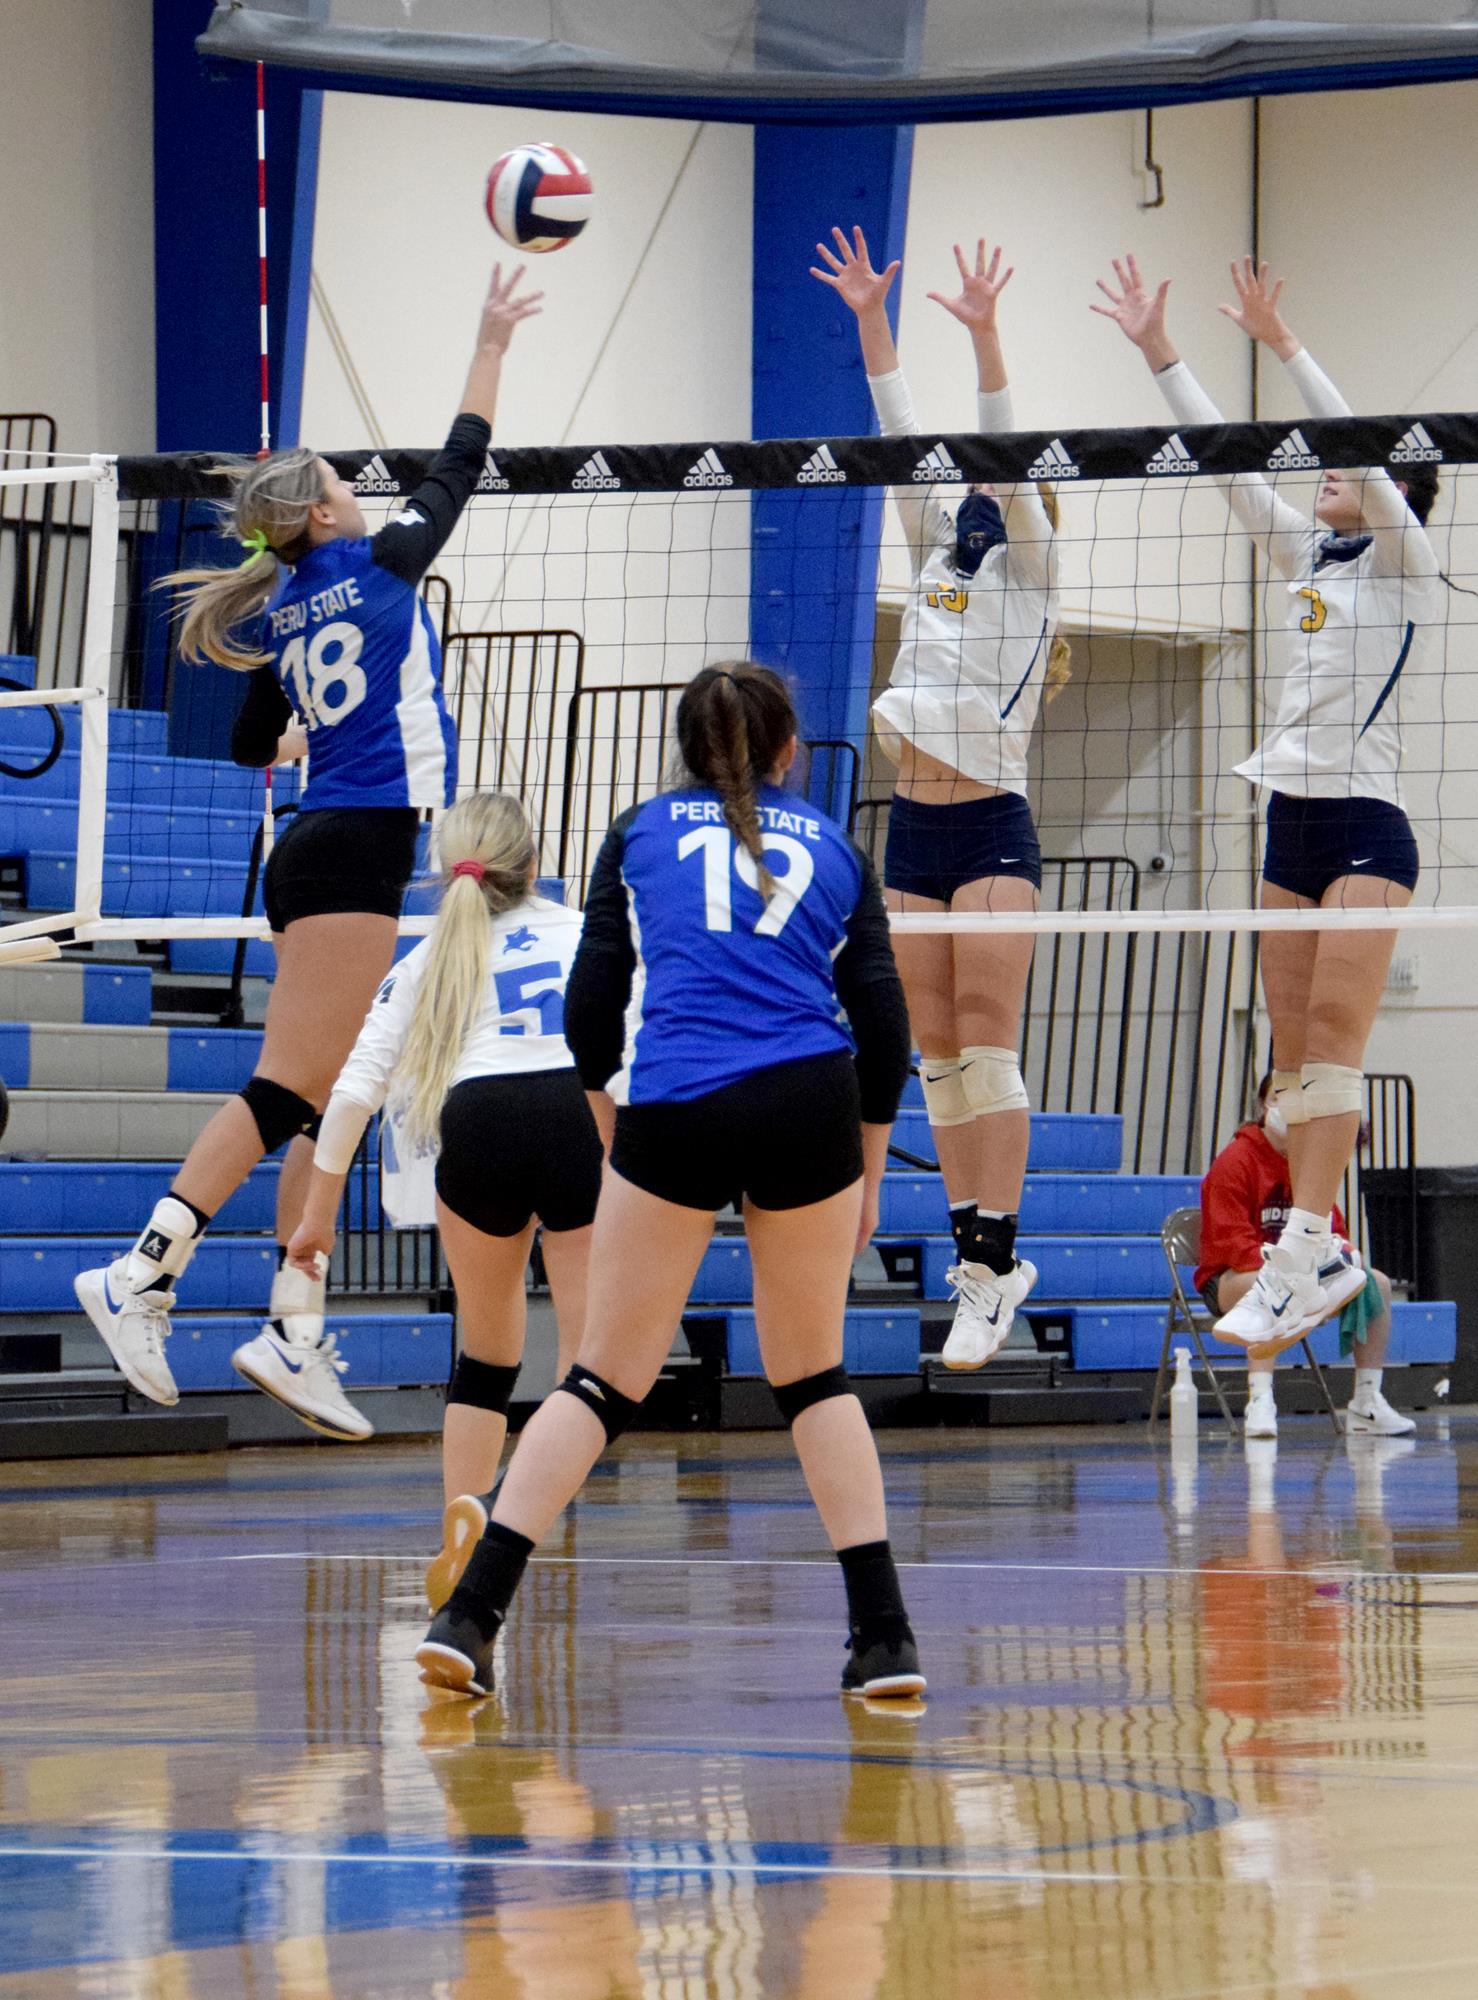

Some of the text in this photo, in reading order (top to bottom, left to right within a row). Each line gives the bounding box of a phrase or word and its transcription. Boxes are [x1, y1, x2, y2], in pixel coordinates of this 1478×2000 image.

[1267, 453, 1320, 469] adidas
[1389, 447, 1443, 463] adidas
[912, 467, 963, 481] adidas
[1027, 463, 1080, 479] adidas
[1146, 458, 1199, 474] adidas
[571, 475, 621, 490] adidas
[683, 472, 733, 487] adidas
[797, 469, 847, 483] adidas
[353, 477, 400, 492] adidas
[269, 577, 364, 638] PERU STATE
[1296, 586, 1327, 633] 3
[280, 621, 367, 731] 18
[670, 801, 727, 822] PER
[678, 826, 815, 937] 19
